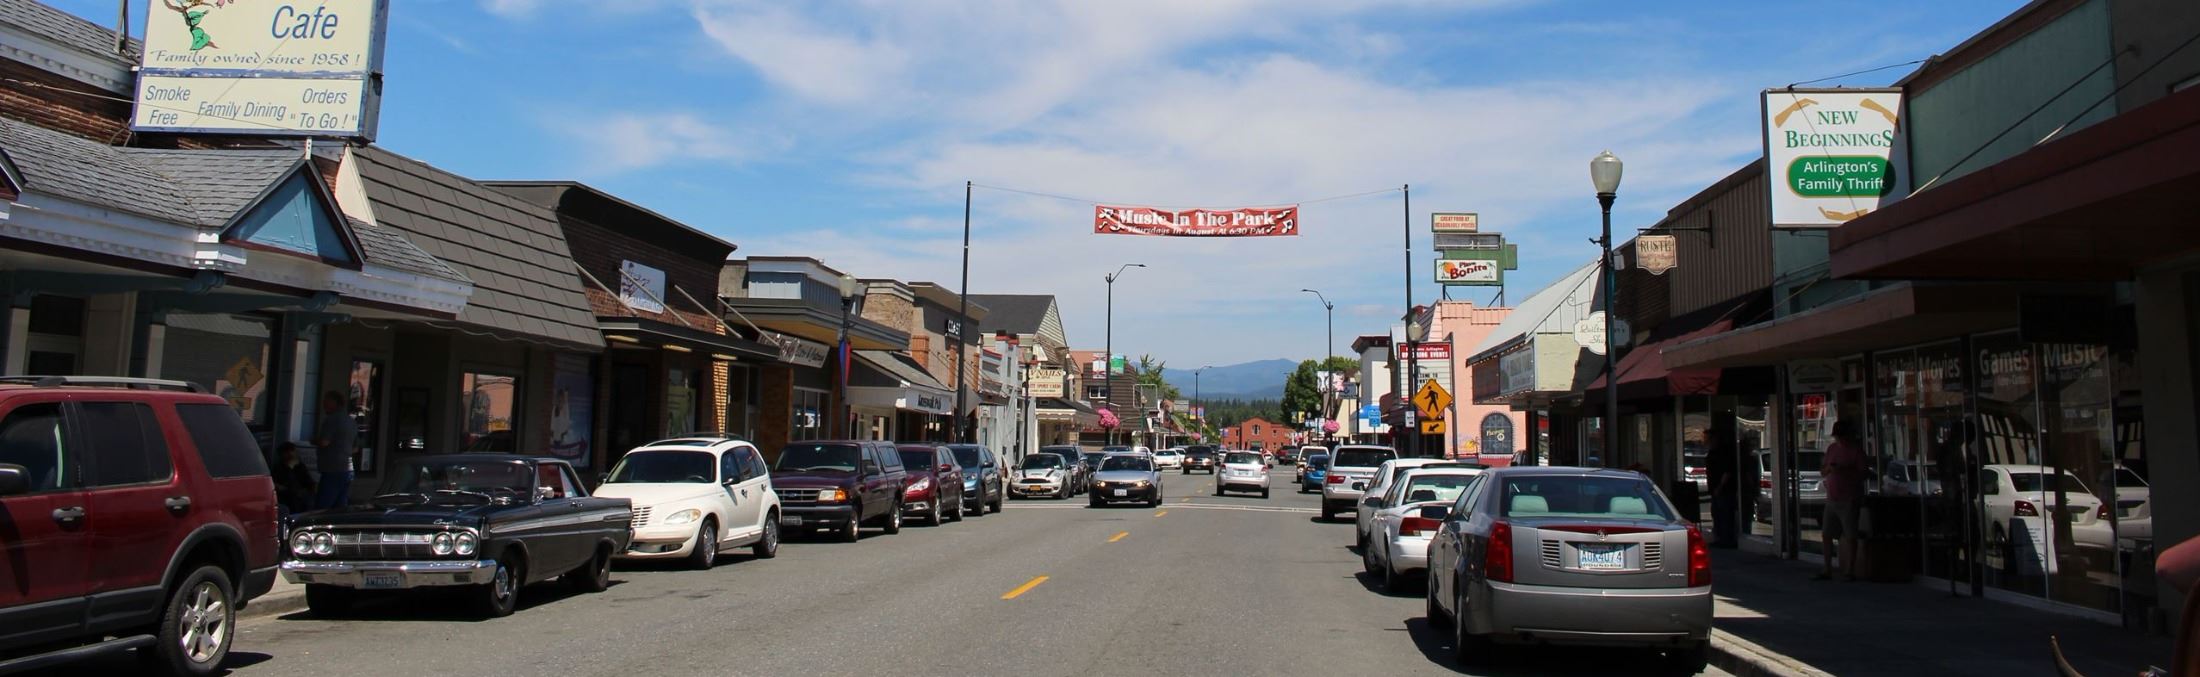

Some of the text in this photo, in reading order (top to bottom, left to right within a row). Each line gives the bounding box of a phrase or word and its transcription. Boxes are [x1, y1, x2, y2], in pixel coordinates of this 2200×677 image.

[272, 5, 338, 39] Cafe
[150, 49, 207, 66] Family
[213, 51, 261, 64] owned
[267, 53, 305, 65] since
[311, 53, 349, 65] 1958
[145, 85, 191, 101] Smoke
[302, 87, 347, 104] Orders
[148, 109, 178, 125] Free
[198, 101, 287, 121] Family Dining
[1818, 110, 1859, 125] NEW
[1785, 130, 1894, 148] BEGINNINGS
[1804, 161, 1878, 175] Arlington's
[1798, 178, 1885, 192] Family Thrift
[1119, 209, 1275, 228] Music In The Park
[1185, 227, 1216, 238] August
[1249, 227, 1265, 236] PM
[1450, 265, 1488, 280] Bonita
[1430, 351, 1449, 359] EVENTS
[1979, 348, 2030, 375] Games
[1919, 352, 1961, 380] Movies
